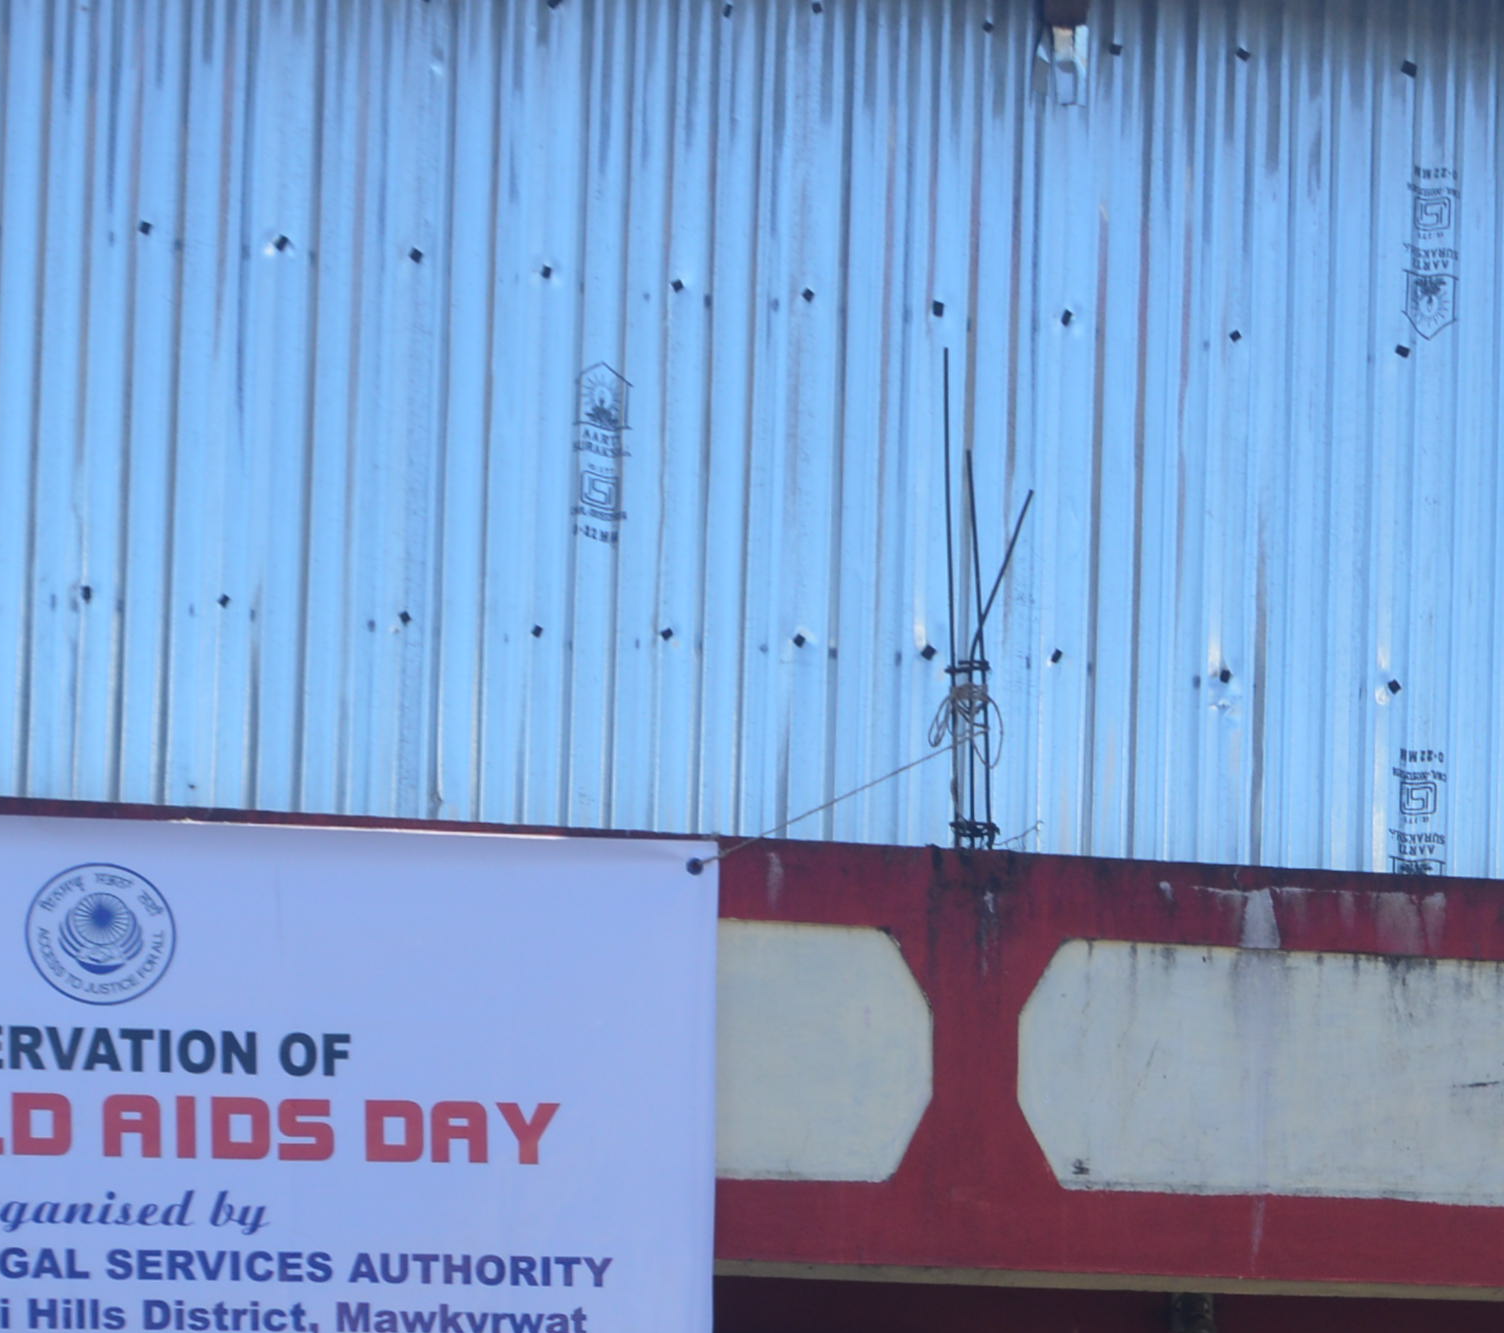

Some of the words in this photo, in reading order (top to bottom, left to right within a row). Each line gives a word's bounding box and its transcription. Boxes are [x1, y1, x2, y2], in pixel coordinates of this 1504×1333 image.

[84, 974, 137, 995] JUSTICE
[279, 1032, 351, 1077] OF
[103, 1094, 335, 1161] AIDS
[365, 1100, 560, 1165] DAY
[210, 1190, 266, 1235] by
[106, 1249, 333, 1283] SERVICES
[348, 1253, 612, 1287] AUTHORITY
[28, 1298, 126, 1330] Hills
